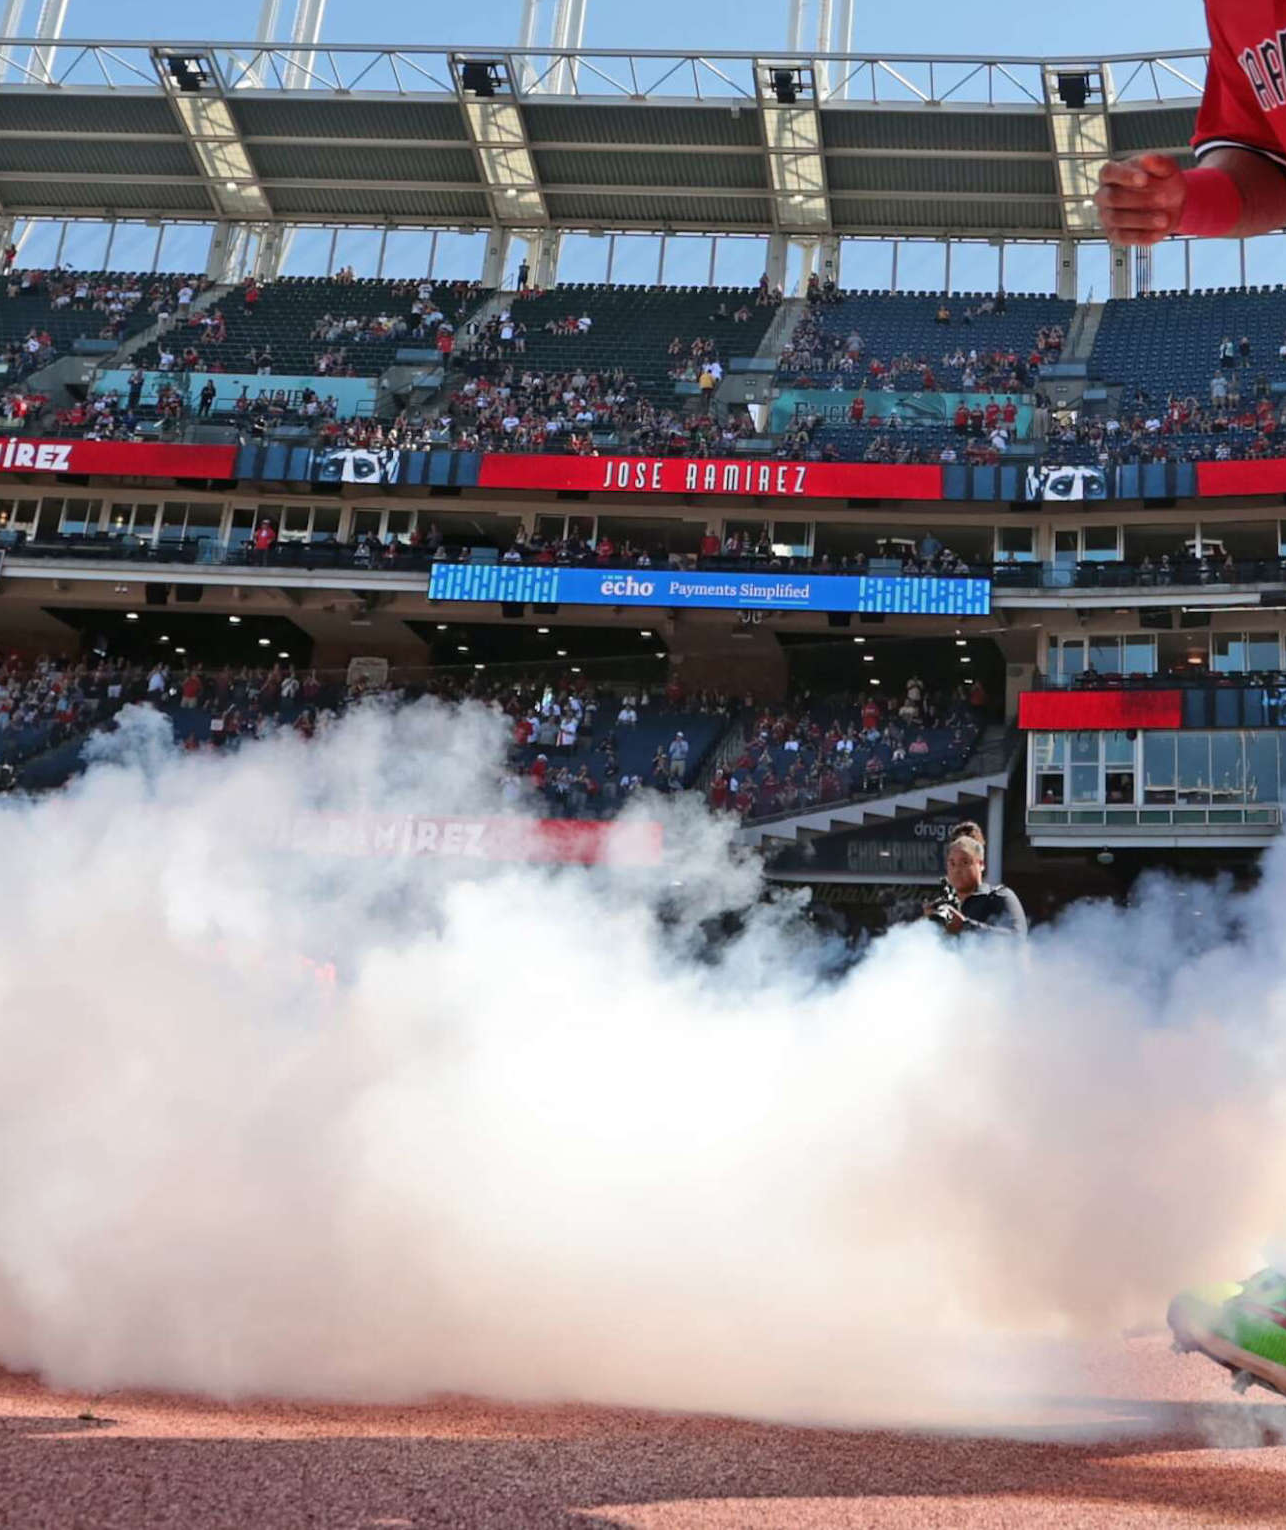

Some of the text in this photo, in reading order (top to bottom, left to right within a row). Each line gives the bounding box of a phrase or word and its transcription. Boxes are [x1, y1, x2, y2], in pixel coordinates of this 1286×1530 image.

[600, 575, 810, 601] echo Payments Simplified
[915, 820, 946, 841] drug
